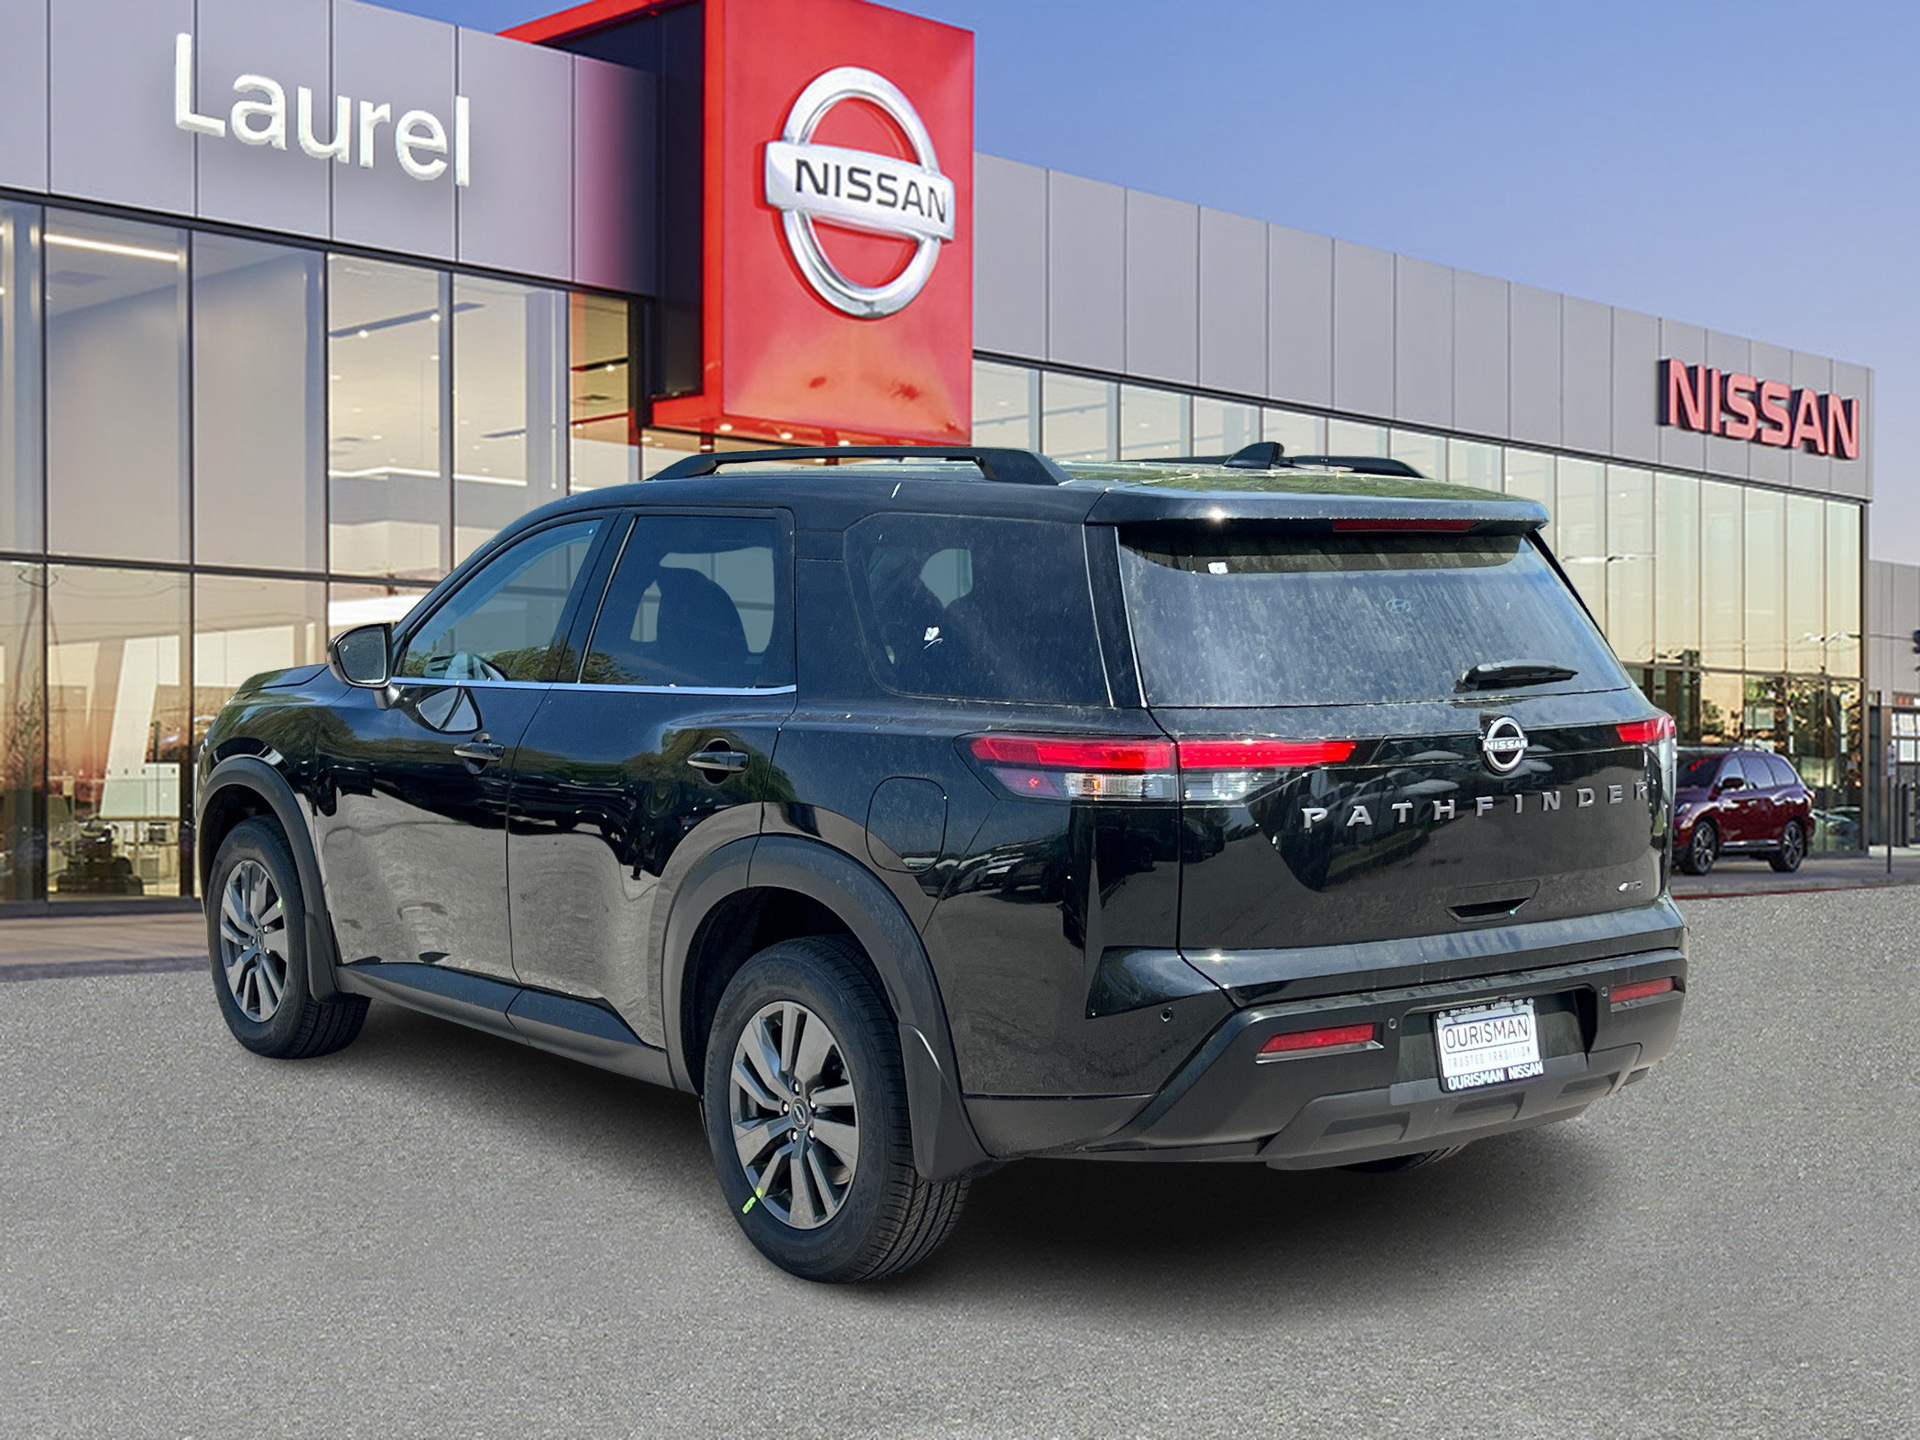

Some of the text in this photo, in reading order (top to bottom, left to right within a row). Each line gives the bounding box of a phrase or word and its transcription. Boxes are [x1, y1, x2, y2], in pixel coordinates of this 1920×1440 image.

[175, 32, 470, 188] Laurel
[794, 157, 947, 224] NISSAN
[1659, 357, 1861, 460] NISSAN
[1484, 739, 1528, 752] NISSAN
[1301, 780, 1649, 830] PATHFINDER
[1445, 1018, 1528, 1048] OURISMAN
[1447, 1053, 1485, 1070] TRUSTED
[1447, 1060, 1544, 1090] OURISMAN NISSAN
